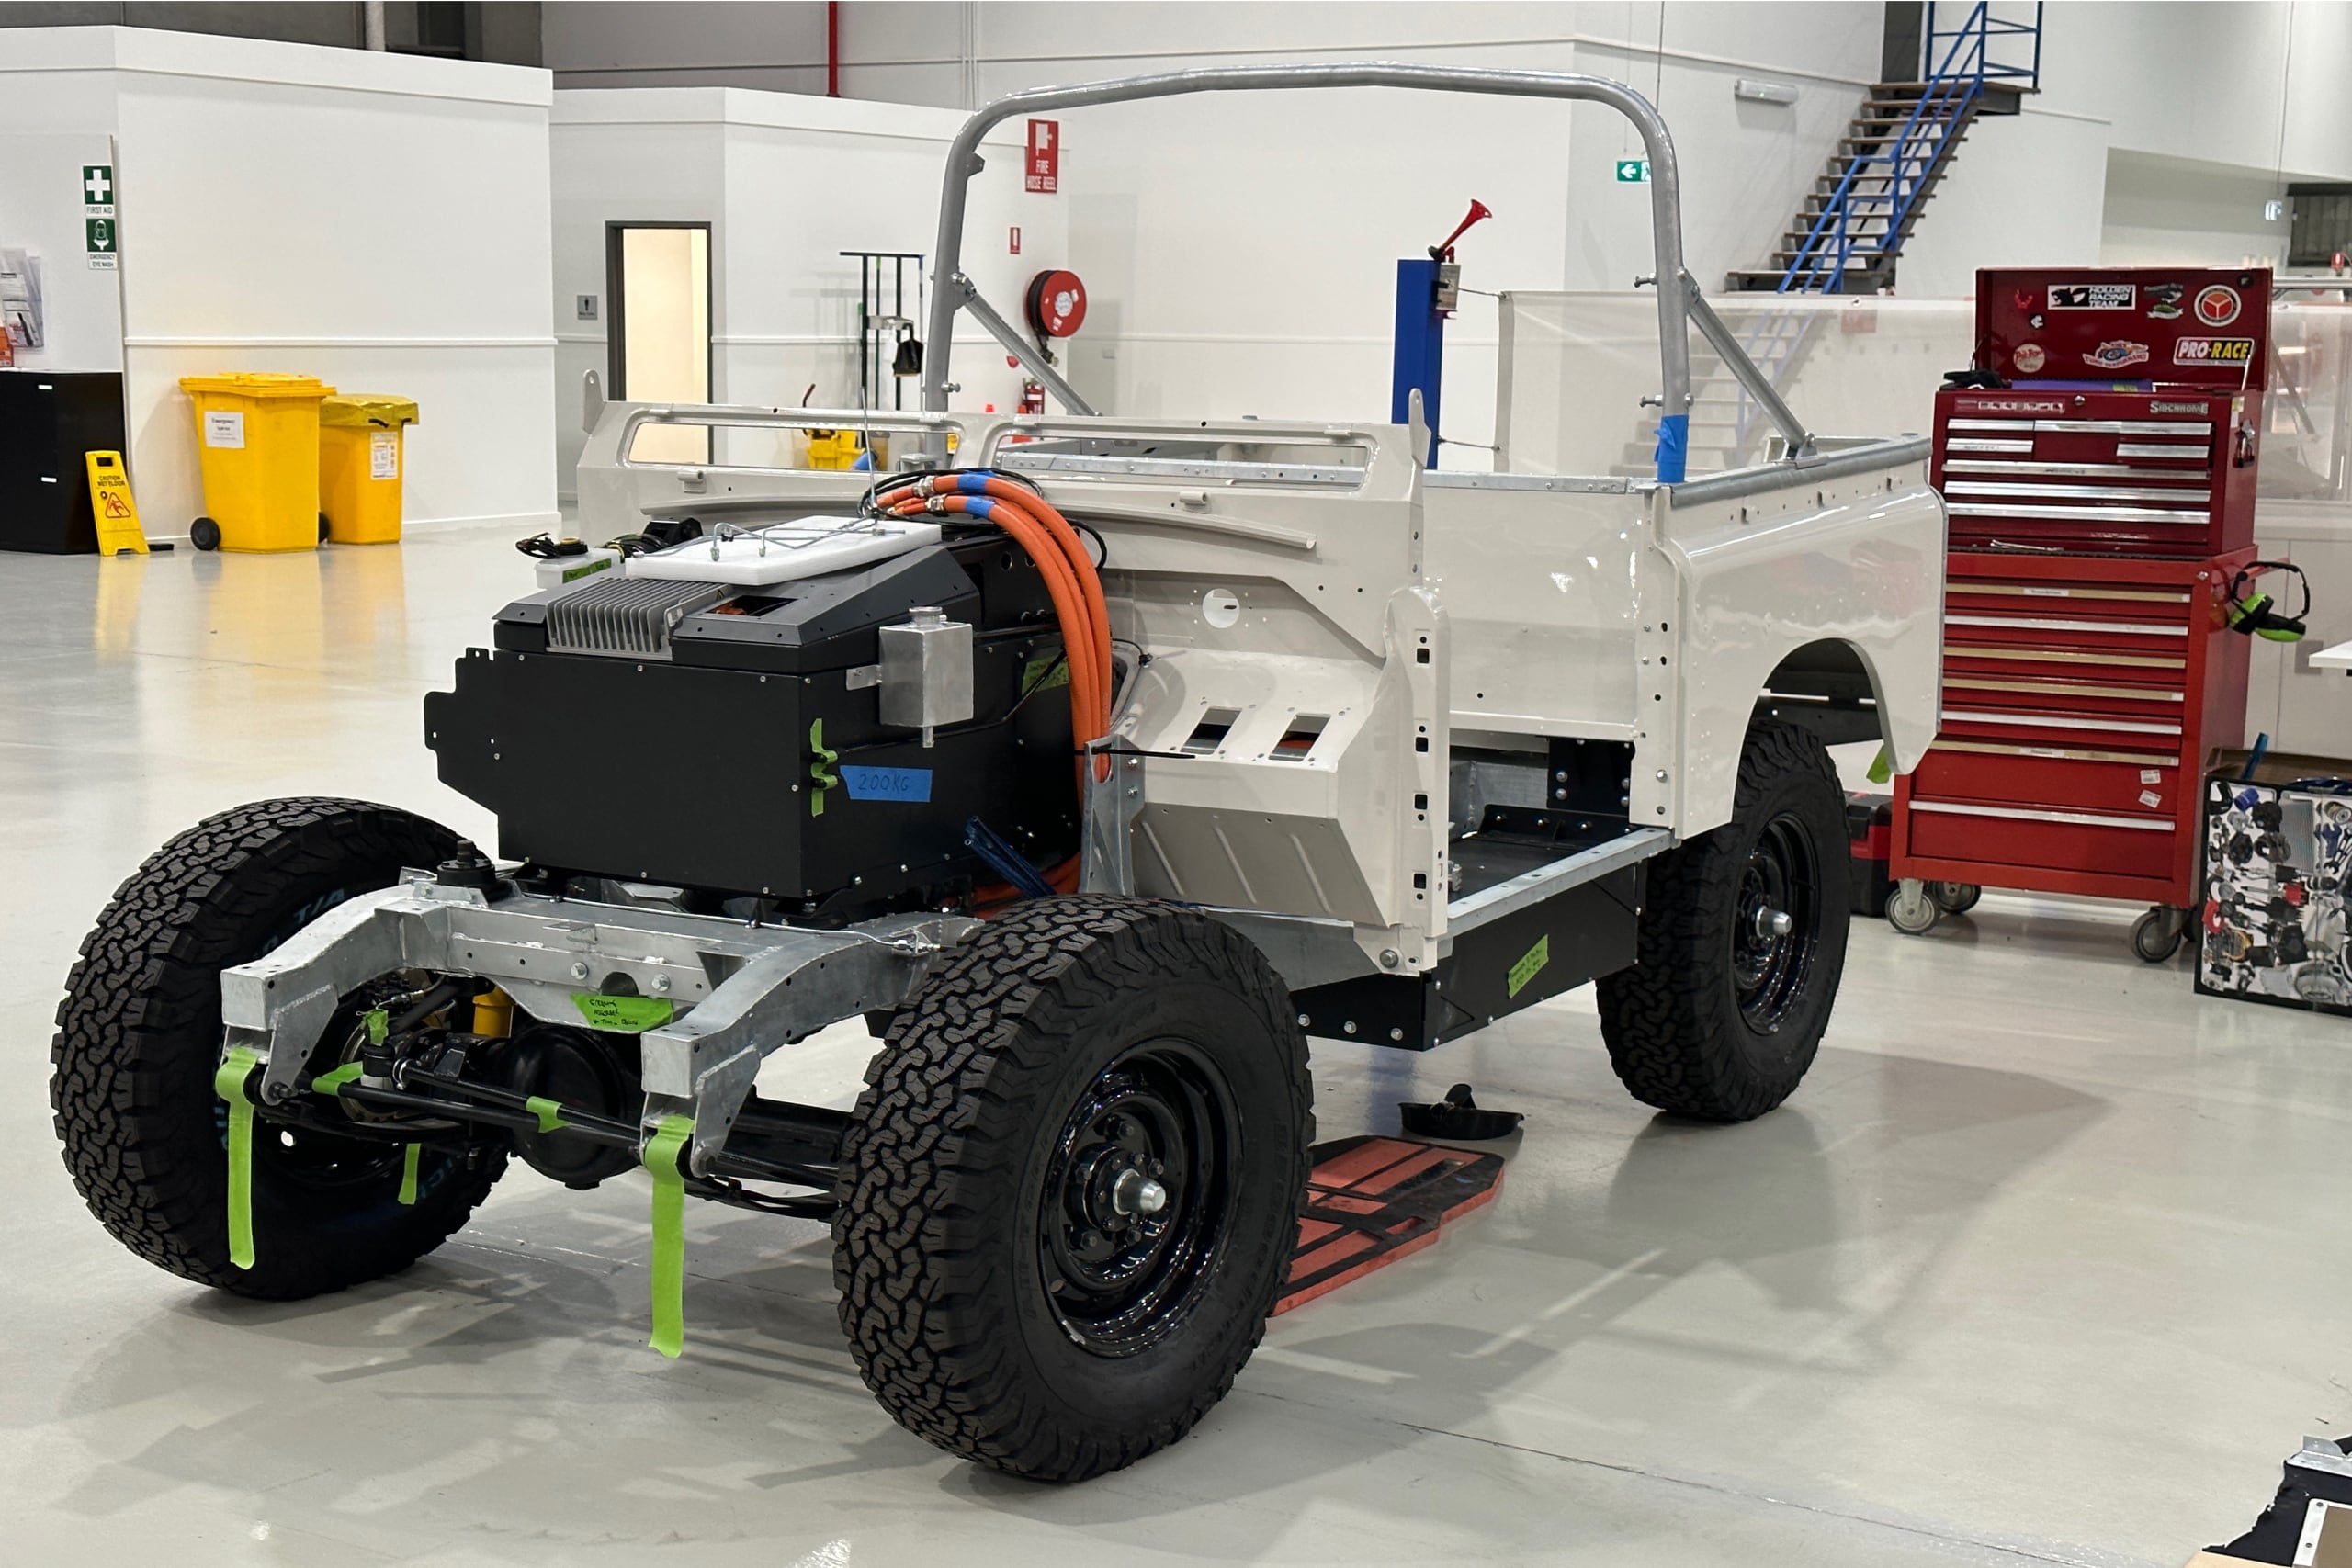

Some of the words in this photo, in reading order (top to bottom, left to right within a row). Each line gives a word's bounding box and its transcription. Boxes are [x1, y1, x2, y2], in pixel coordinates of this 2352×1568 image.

[1035, 159, 1049, 174] FIRE
[1027, 175, 1042, 189] HOSE
[1043, 176, 1056, 190] REEL
[86, 206, 102, 214] FIRST
[103, 206, 113, 214] AID
[2088, 285, 2132, 294] HOLDEN
[2177, 341, 2249, 359] PRO-RACE
